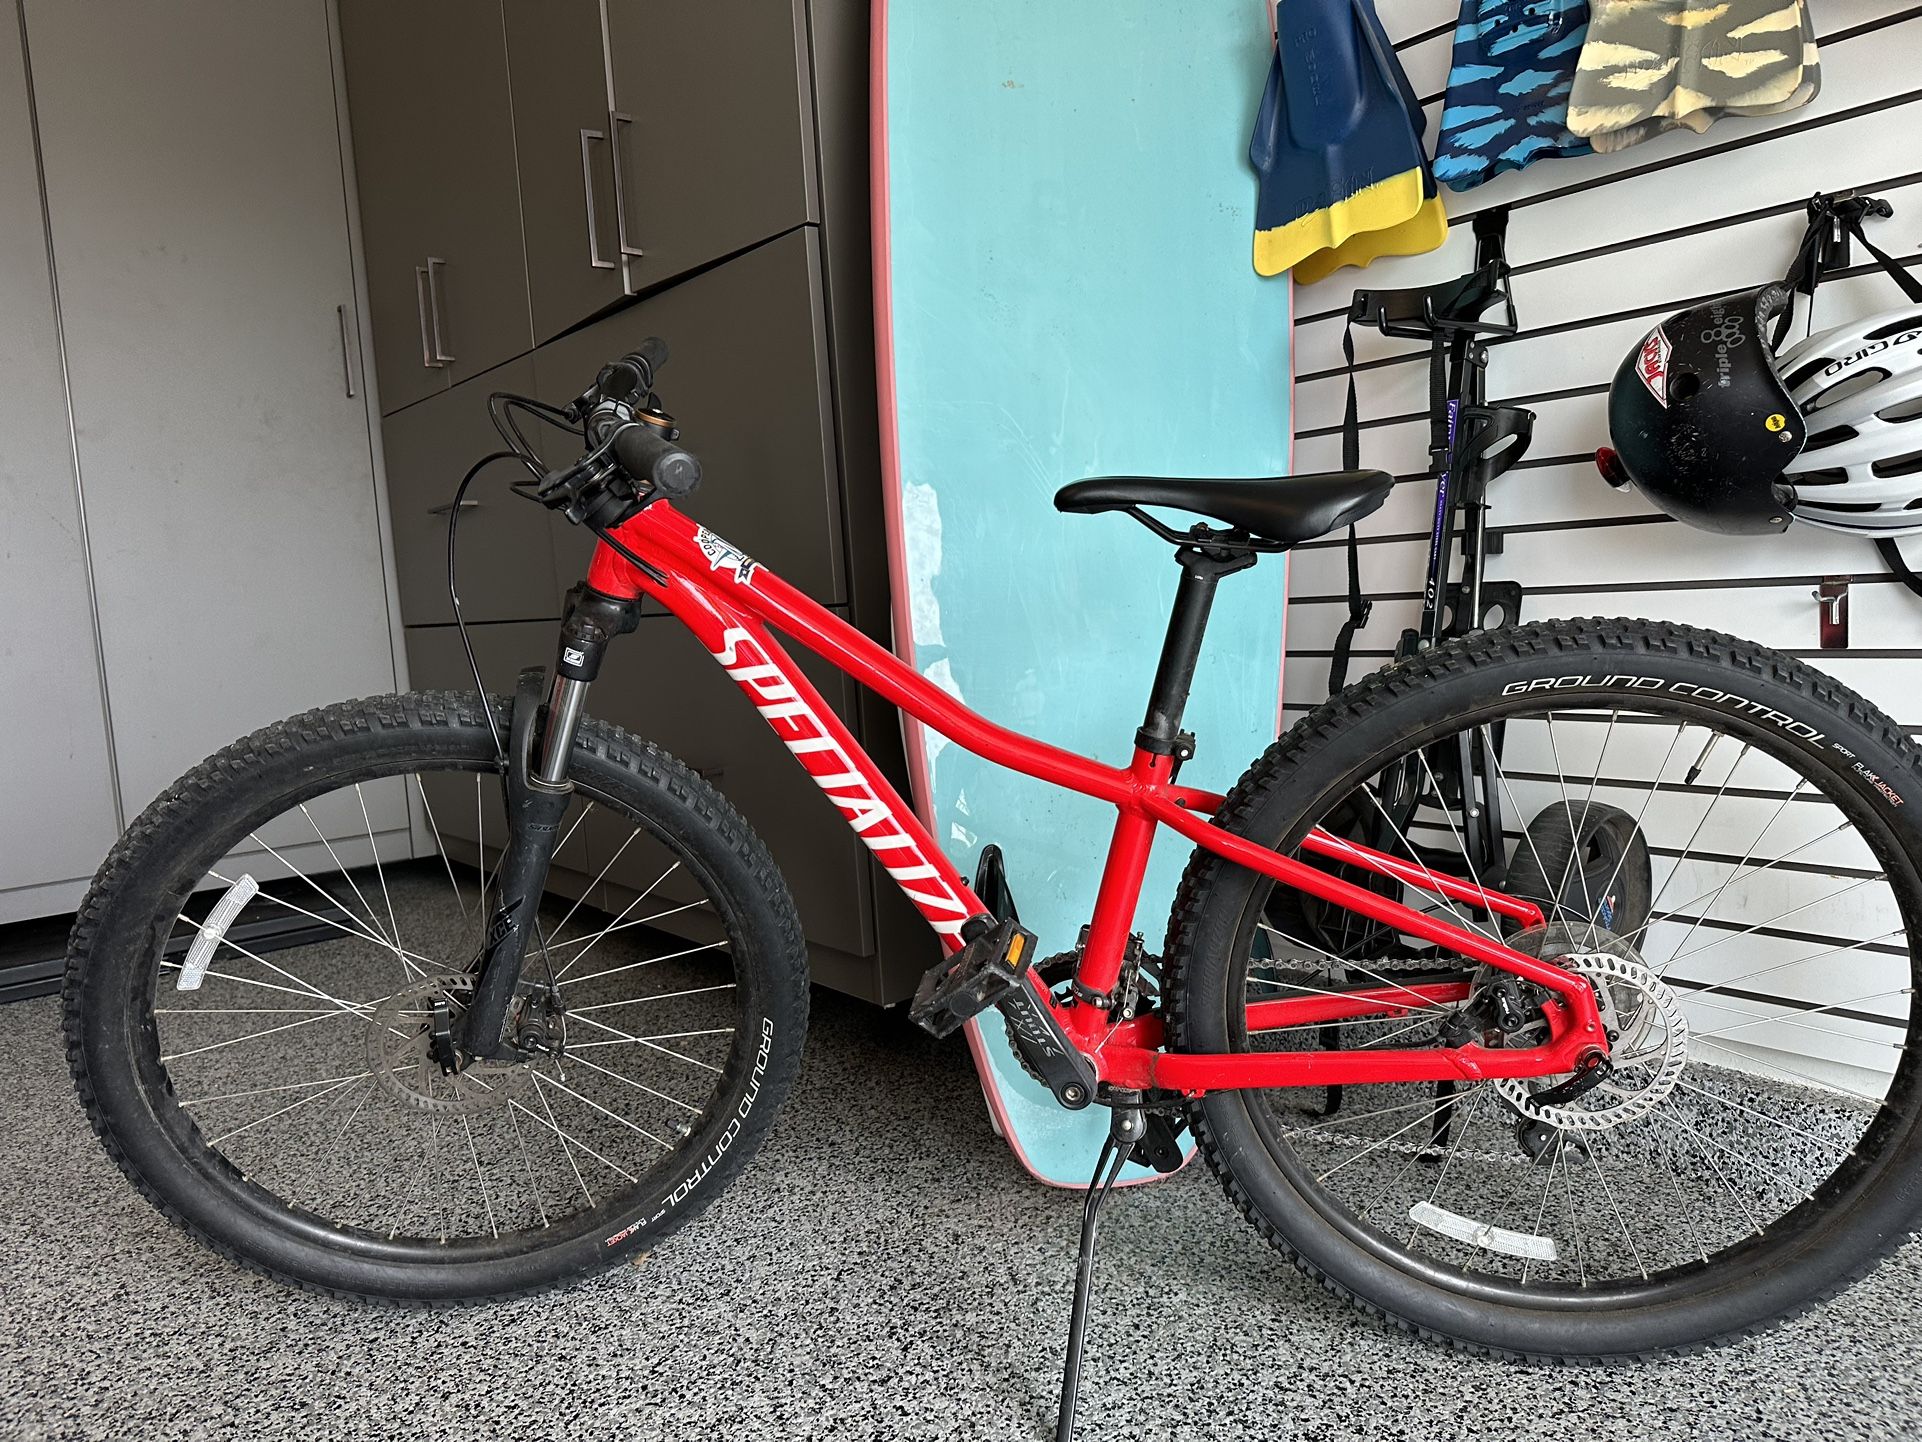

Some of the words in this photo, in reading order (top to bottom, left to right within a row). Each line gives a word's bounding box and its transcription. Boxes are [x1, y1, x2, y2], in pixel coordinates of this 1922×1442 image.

[1643, 336, 1665, 384] JACKS
[1716, 343, 1731, 388] triple
[1824, 340, 1889, 377] GIRO
[1502, 675, 1666, 697] GROUND
[1668, 682, 1825, 750] CONTROL
[1832, 742, 1856, 759] SPORT
[1873, 780, 1905, 805] JACKET
[738, 1016, 774, 1119] GROUND
[661, 1117, 741, 1207] CONTROL
